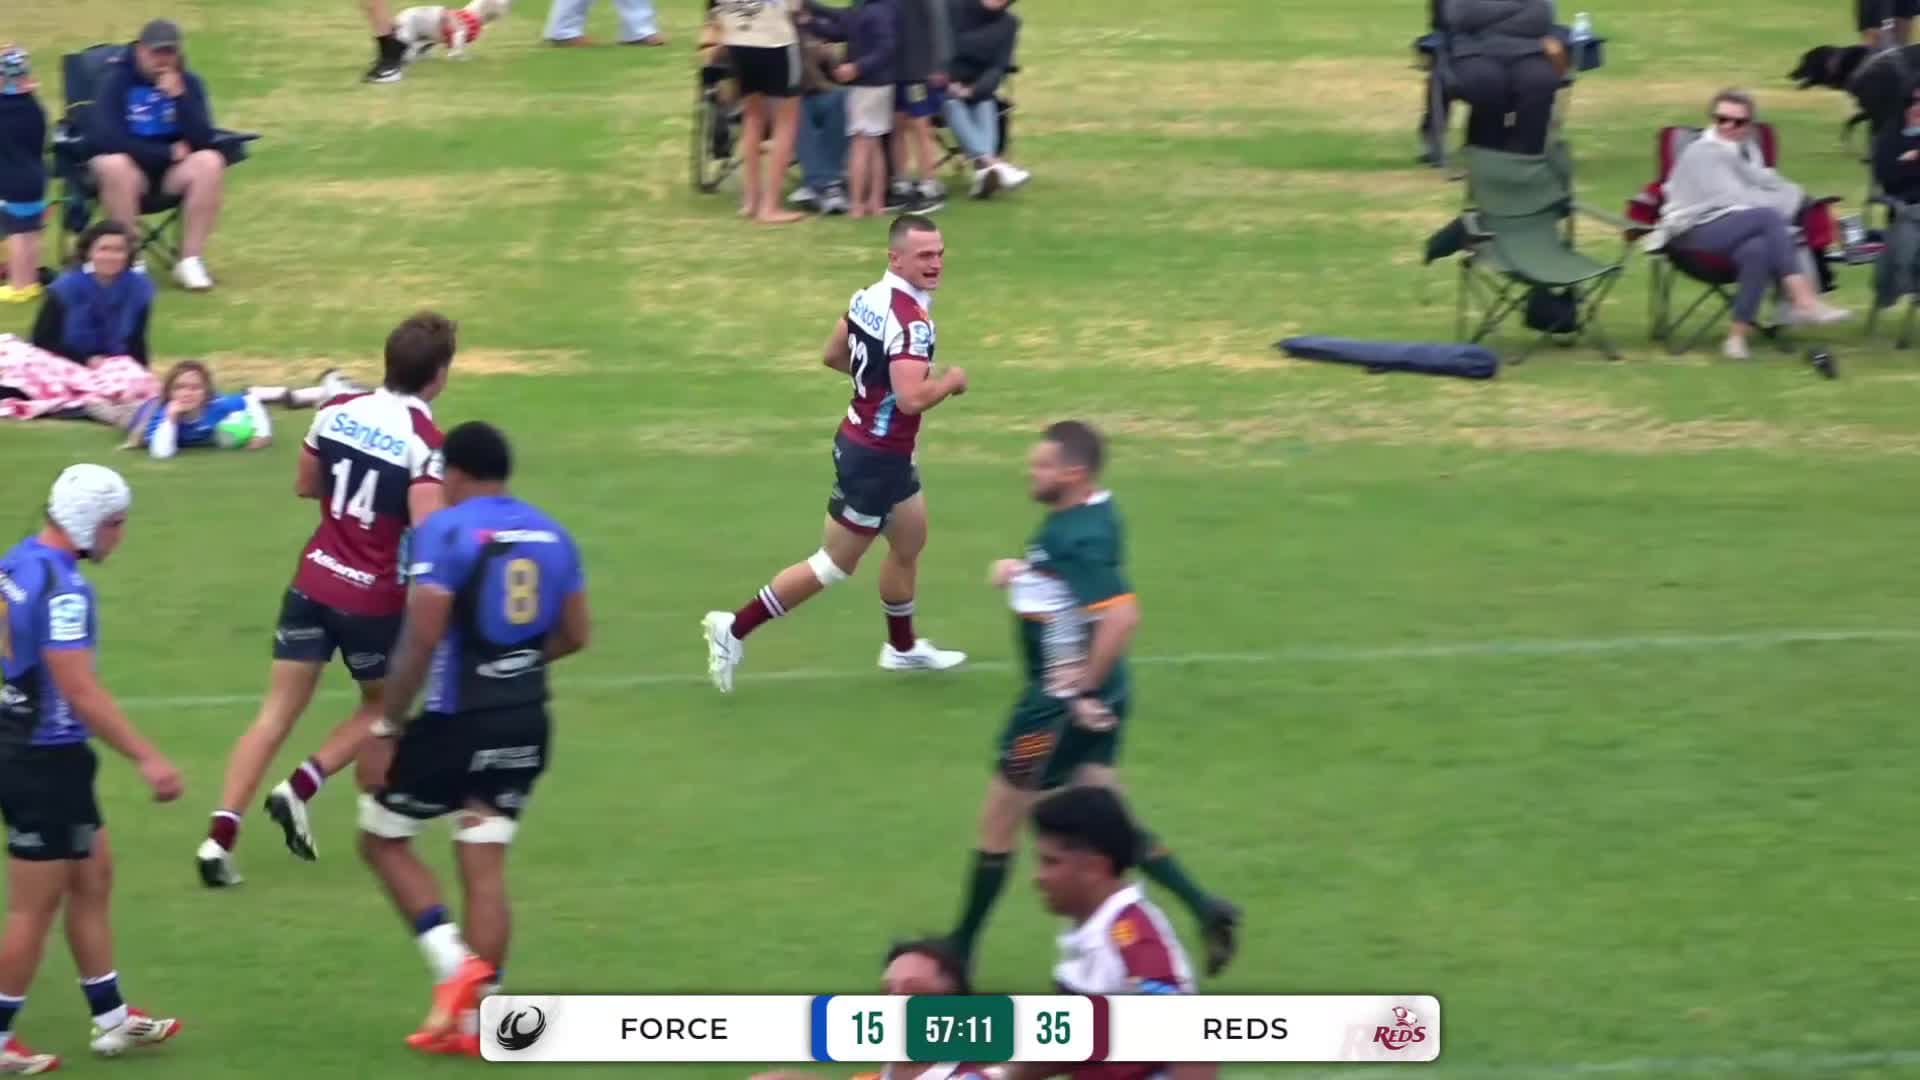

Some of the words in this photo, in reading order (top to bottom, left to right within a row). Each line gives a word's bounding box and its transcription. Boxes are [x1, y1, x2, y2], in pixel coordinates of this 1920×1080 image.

[330, 412, 406, 457] Santos
[331, 457, 380, 530] 14
[503, 557, 540, 625] 8
